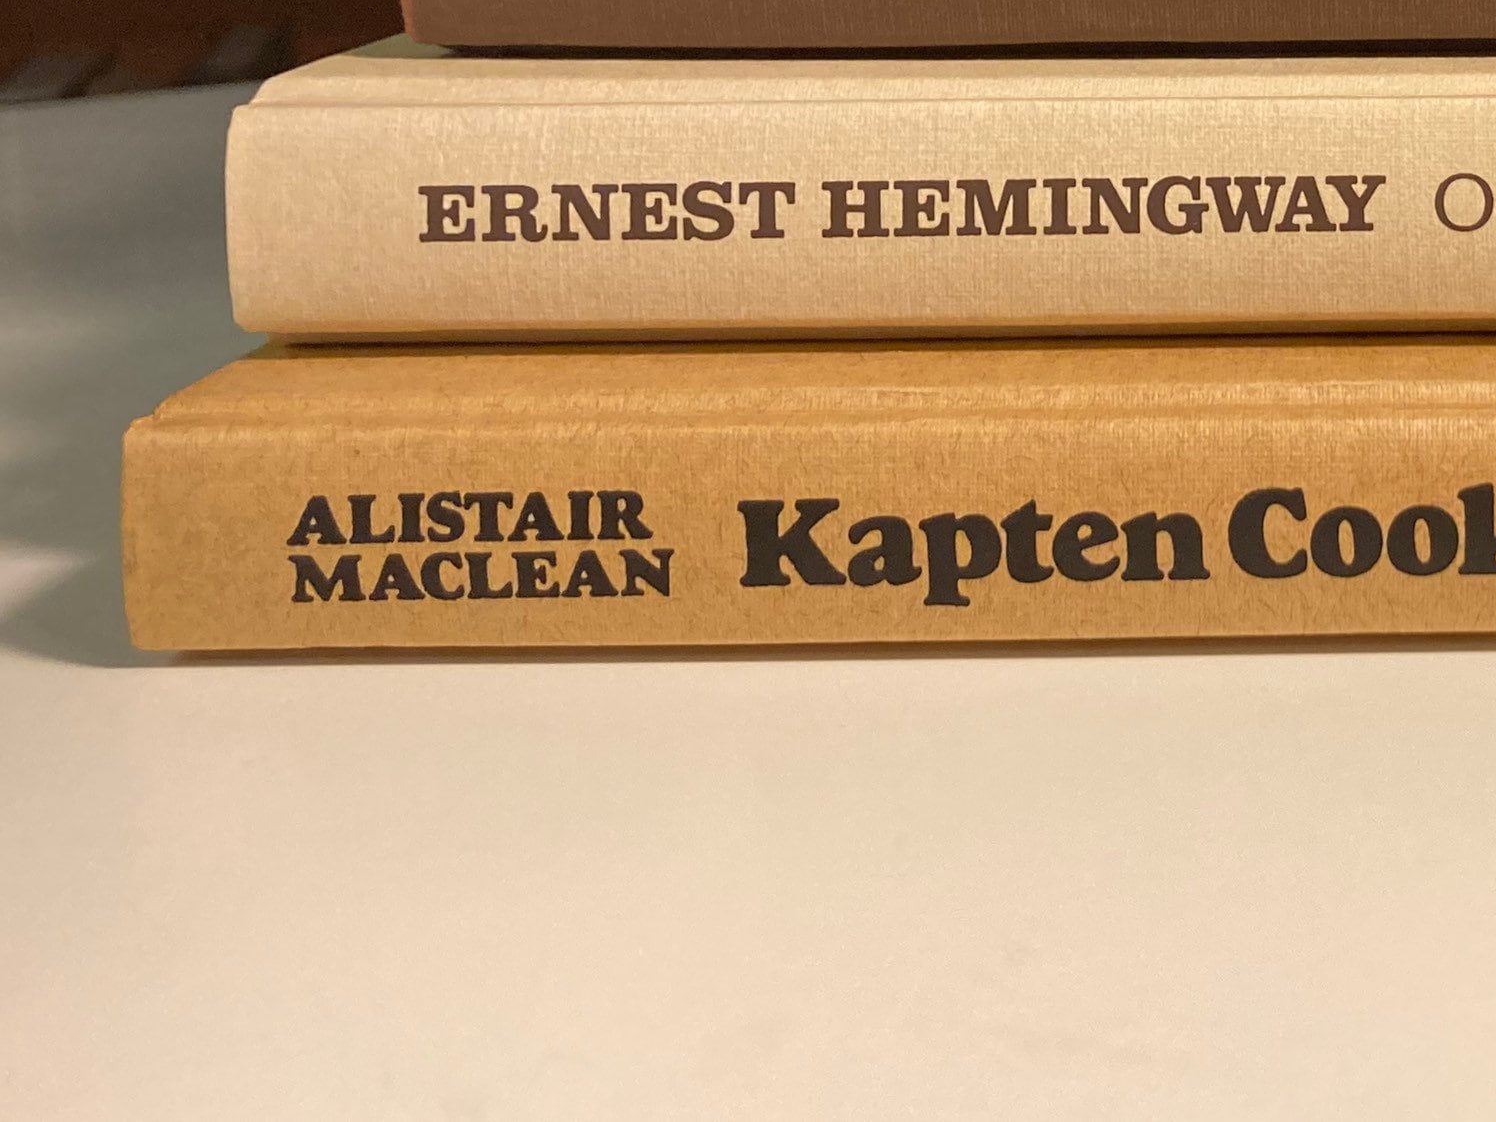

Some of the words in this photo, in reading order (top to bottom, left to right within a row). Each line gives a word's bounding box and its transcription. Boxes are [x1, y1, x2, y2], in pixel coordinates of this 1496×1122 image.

[418, 181, 795, 243] ERNEST
[822, 175, 1386, 238] HEMINGWAY
[287, 490, 654, 546] ALISTAIR
[290, 549, 675, 603] MACLEAN
[738, 498, 1210, 607] Kapten
